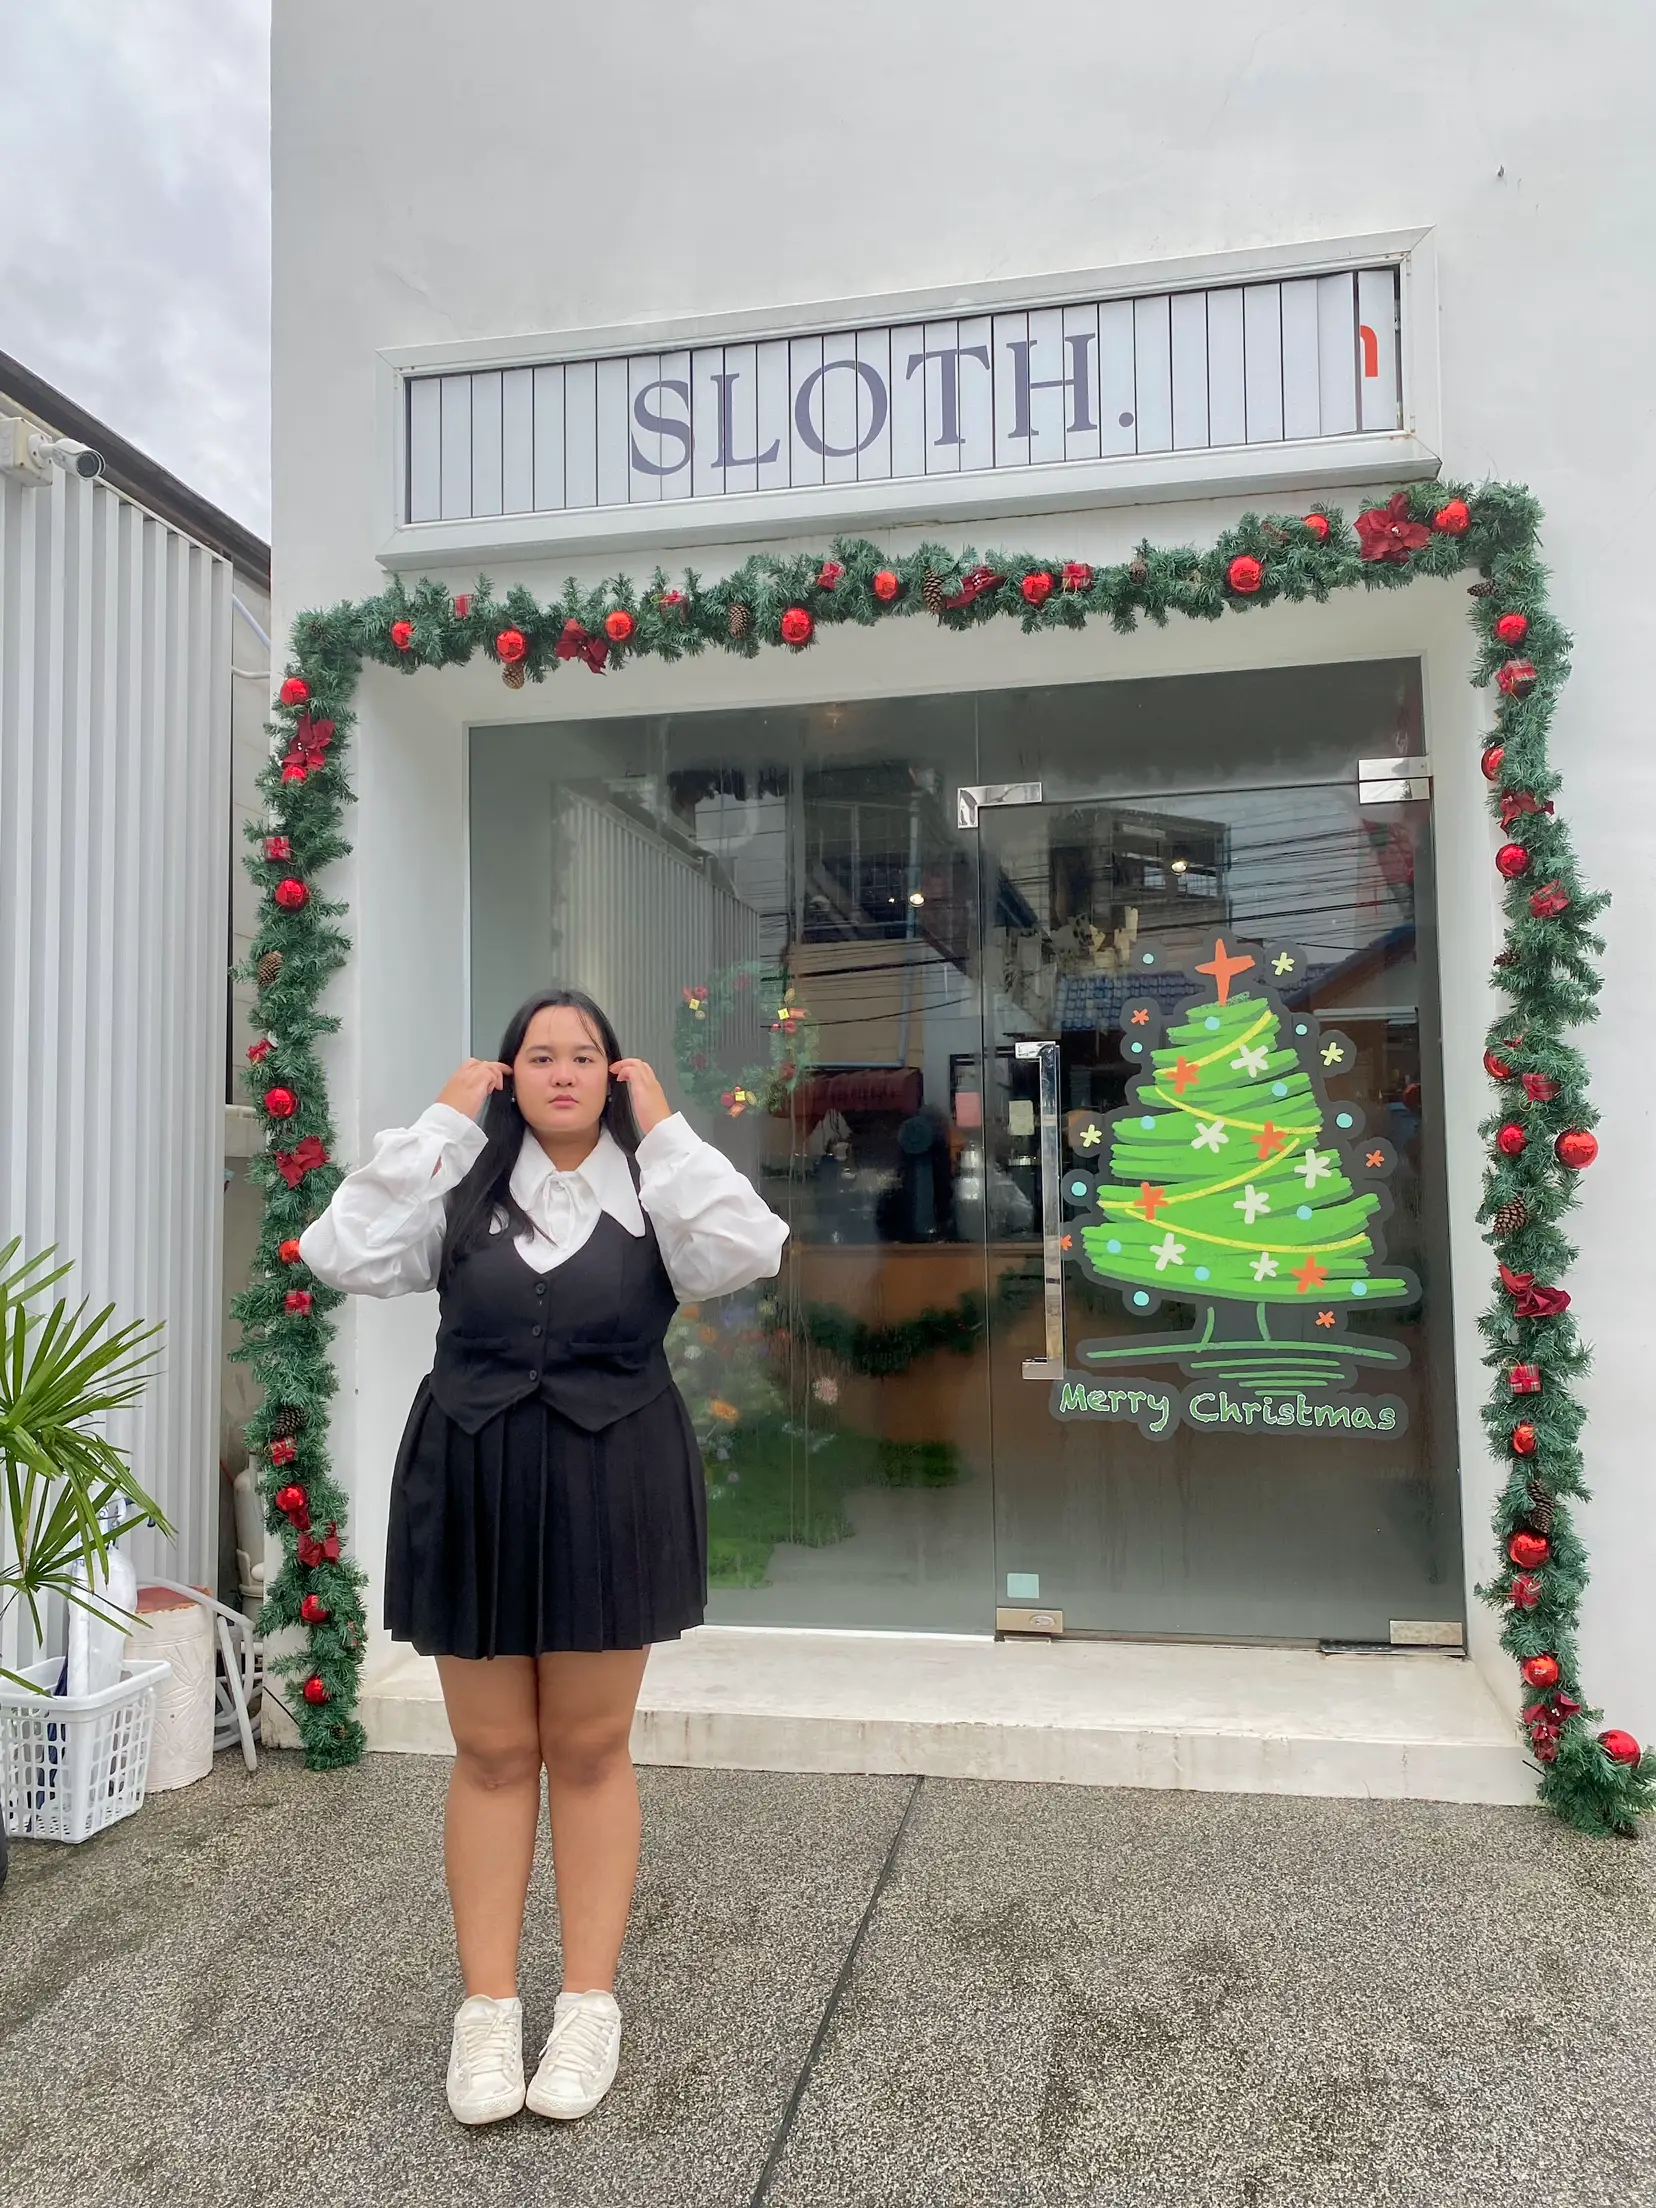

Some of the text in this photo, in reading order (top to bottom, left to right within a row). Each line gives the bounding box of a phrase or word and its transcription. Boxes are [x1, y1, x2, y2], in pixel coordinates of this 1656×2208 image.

[631, 332, 1135, 476] SLOTH.
[1059, 1382, 1396, 1432] Merry Christmas
